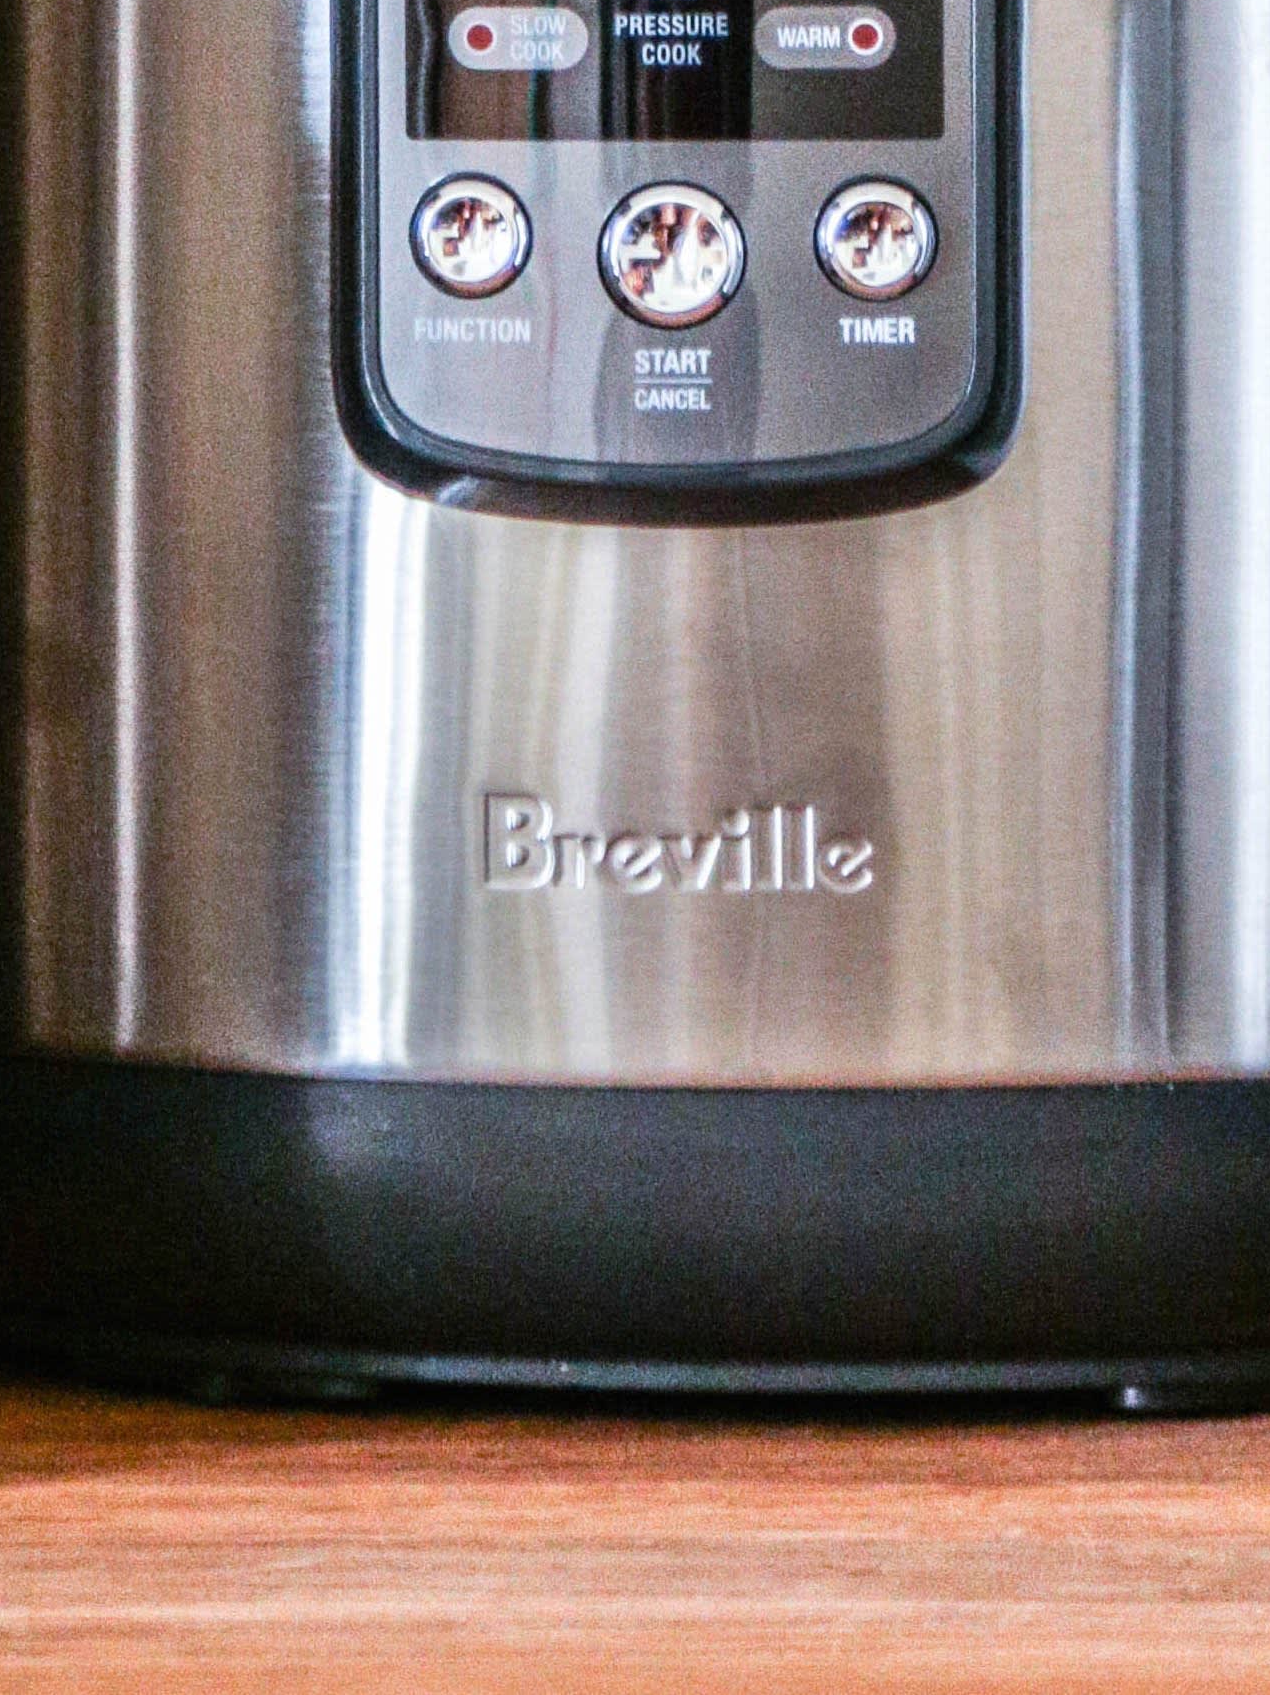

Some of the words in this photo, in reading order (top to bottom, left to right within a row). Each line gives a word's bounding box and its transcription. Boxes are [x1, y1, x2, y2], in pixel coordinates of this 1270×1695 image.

[510, 14, 566, 37] SLOW
[615, 14, 729, 37] PRESSURE
[777, 26, 840, 49] WARM
[510, 41, 565, 64] COOK
[642, 42, 702, 66] COOK
[414, 318, 530, 344] FUNCTION
[839, 318, 916, 344] TIMER
[635, 349, 711, 375] START
[635, 388, 711, 411] CANCEL
[485, 793, 873, 895] Breville
